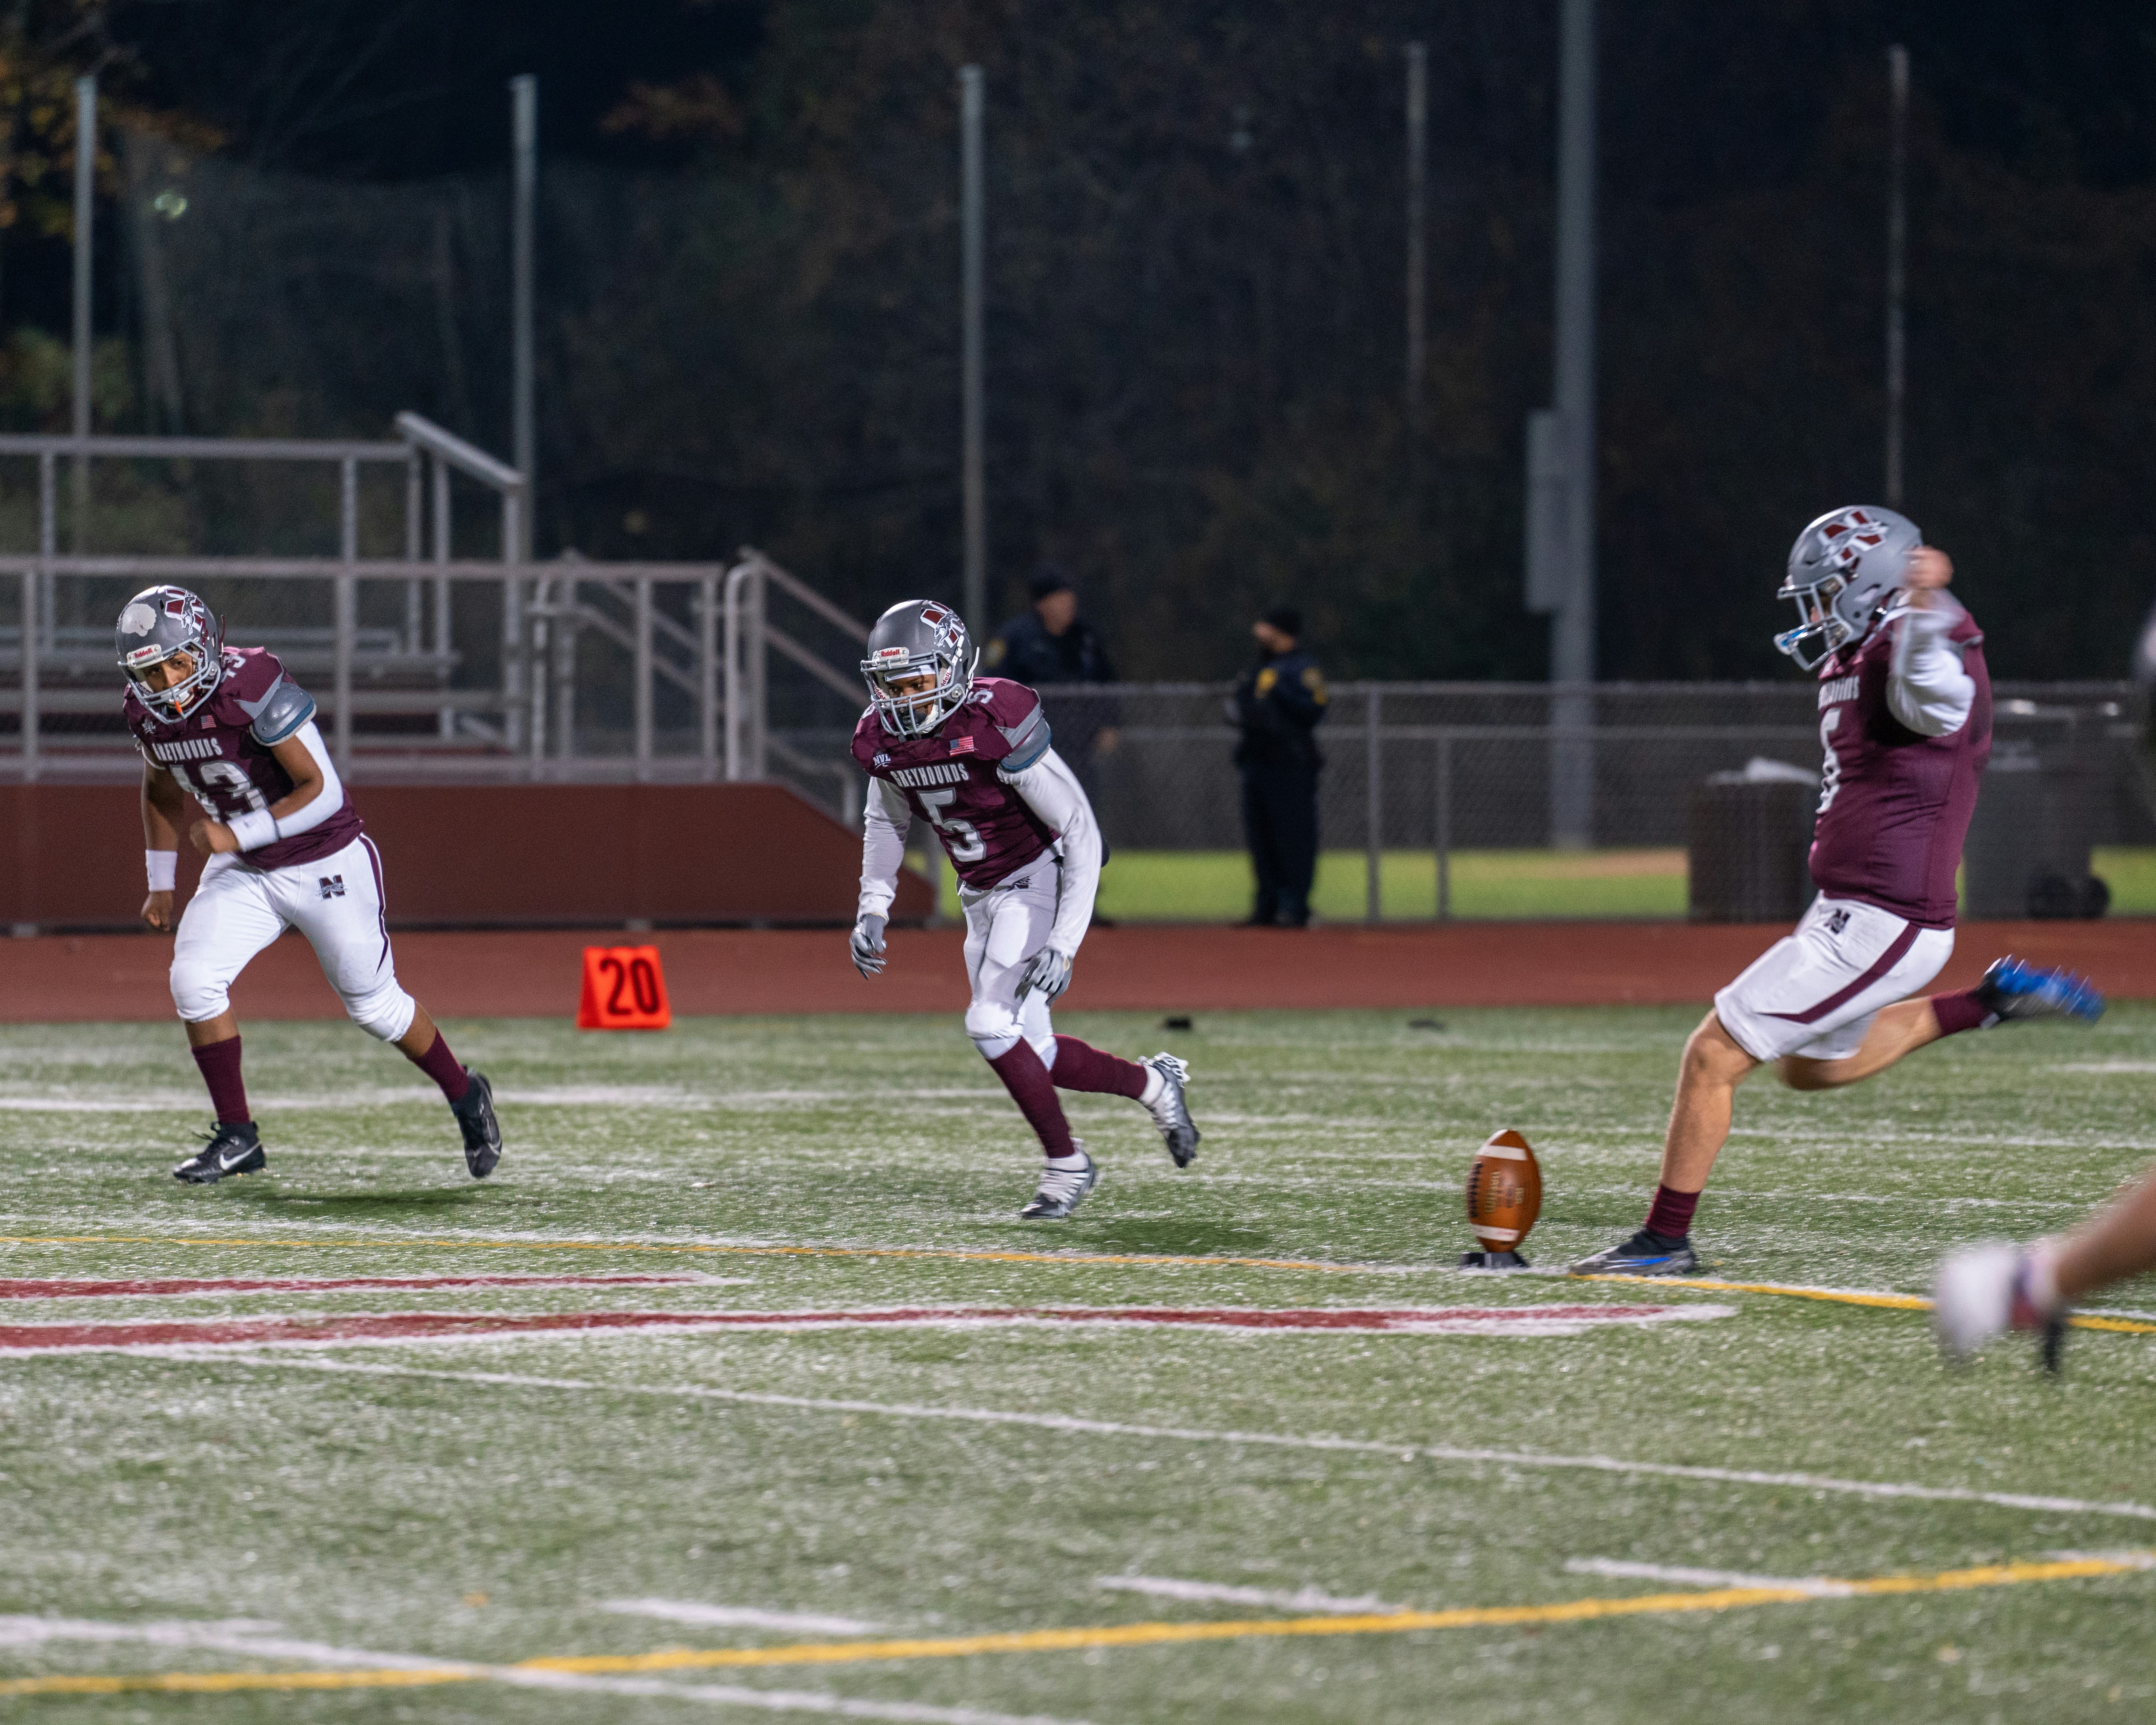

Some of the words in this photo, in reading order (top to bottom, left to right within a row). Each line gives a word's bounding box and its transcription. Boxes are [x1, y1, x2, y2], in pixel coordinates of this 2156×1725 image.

[881, 649, 900, 657] Riddell
[873, 754, 891, 766] NVL
[890, 762, 969, 787] GREYHOUNDS
[916, 787, 986, 862] 5
[599, 958, 659, 1015] 20
